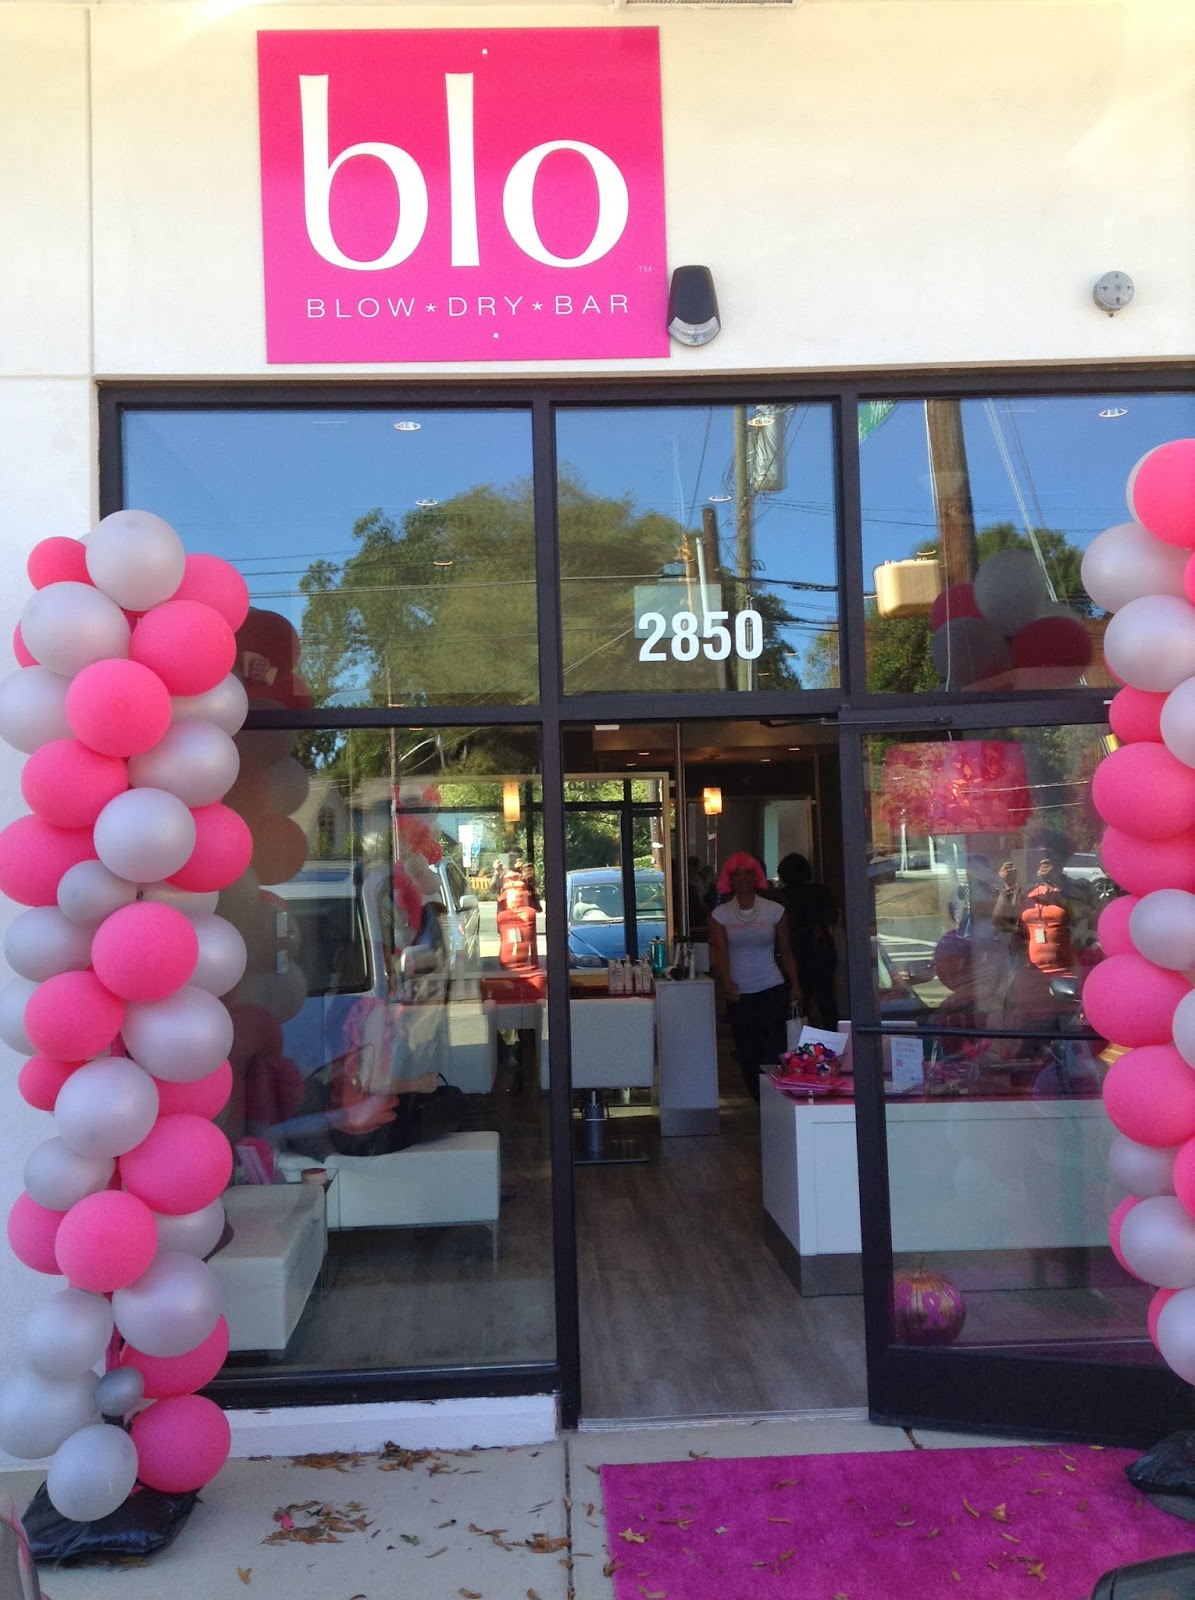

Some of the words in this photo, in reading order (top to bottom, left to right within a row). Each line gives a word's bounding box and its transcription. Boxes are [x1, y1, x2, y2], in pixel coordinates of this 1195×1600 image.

[298, 72, 630, 272] blo
[555, 294, 629, 315] BAR
[638, 609, 764, 663] 2850
